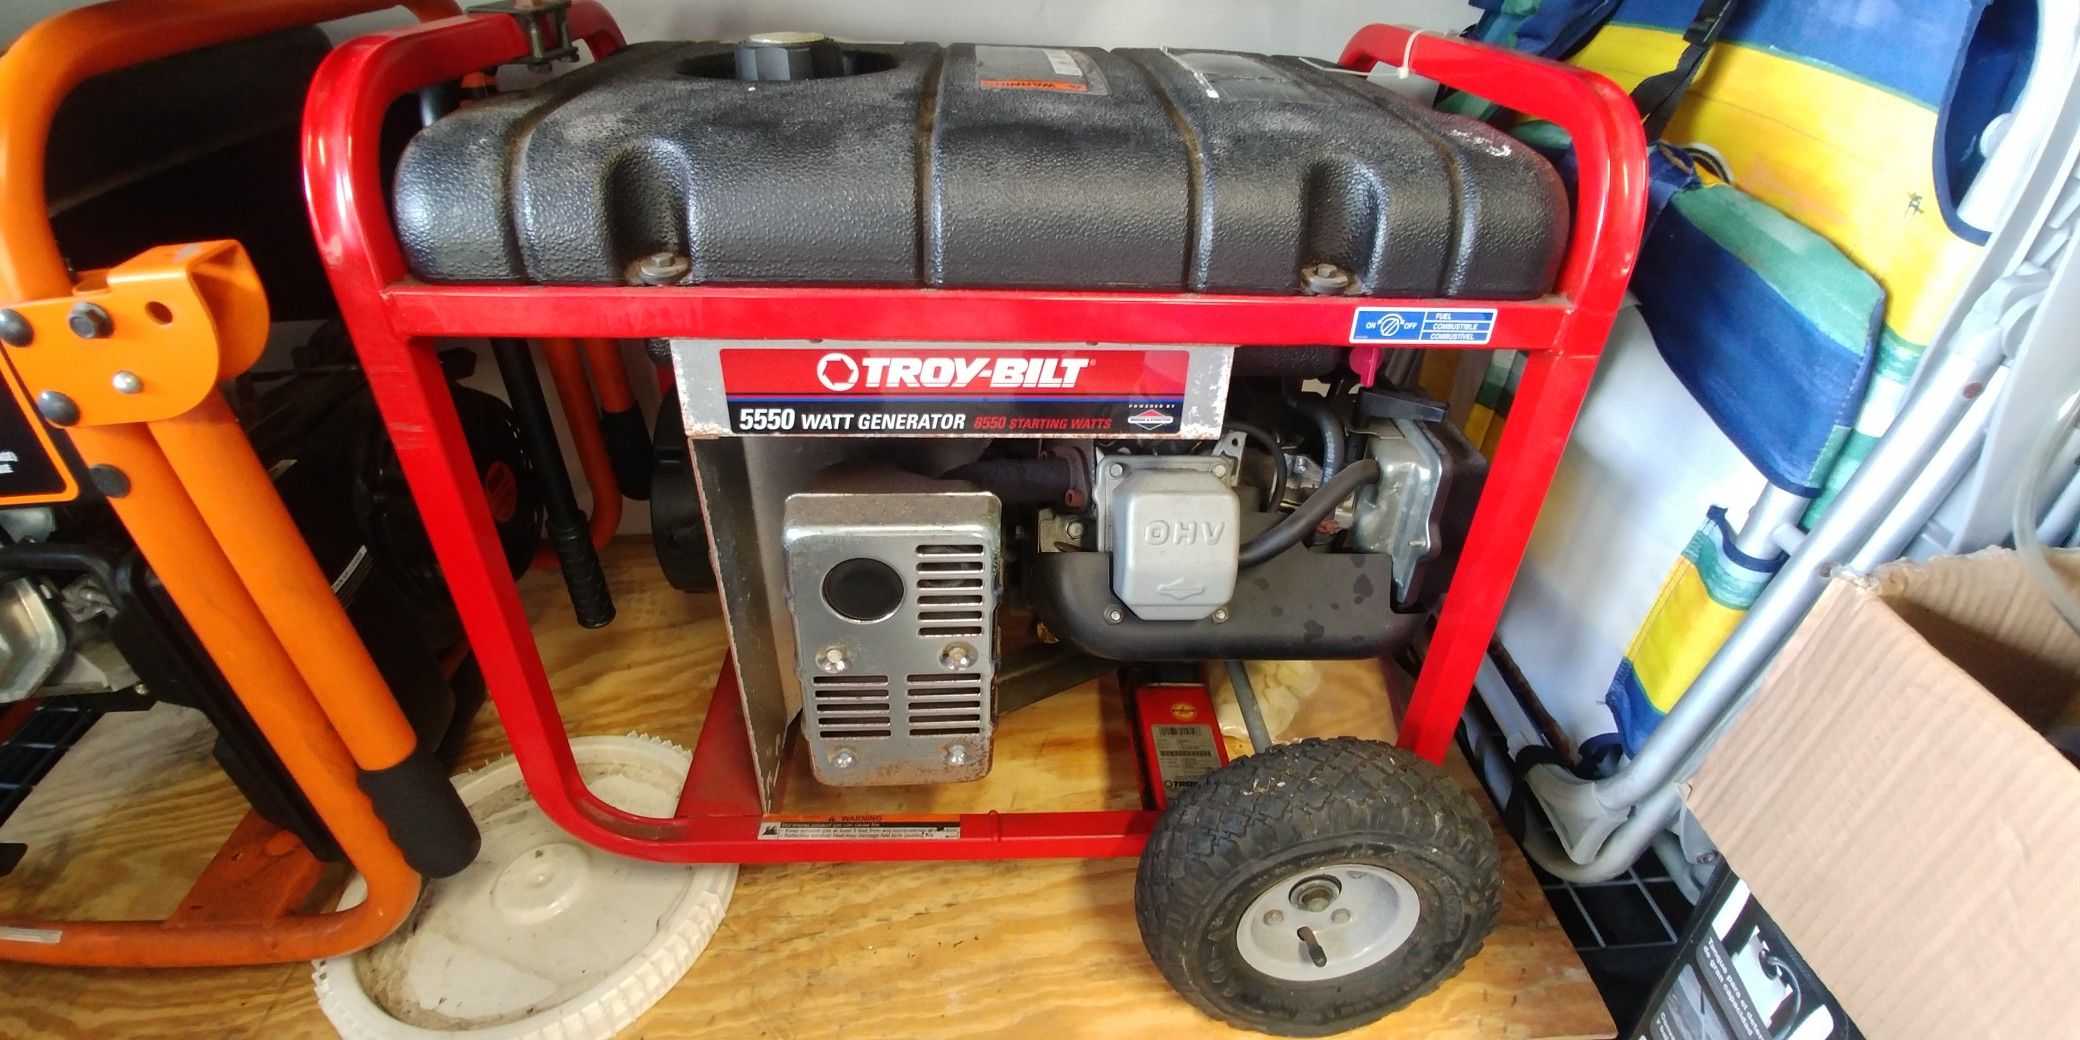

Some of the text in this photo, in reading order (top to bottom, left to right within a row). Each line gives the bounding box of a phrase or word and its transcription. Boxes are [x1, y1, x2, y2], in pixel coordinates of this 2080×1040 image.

[1432, 323, 1478, 331] COMBUSTIBLE
[862, 357, 1090, 388] TROY-BILT
[739, 408, 796, 430] 5550
[801, 413, 855, 430] WATT
[858, 413, 966, 430] GENERATOR
[1009, 417, 1067, 430] STARTING
[1070, 417, 1112, 430] WATTS
[1144, 519, 1225, 546] OHV
[1704, 946, 1753, 1036] de gran capacidad
[1708, 937, 1728, 974] Tanque
[1726, 975, 1740, 998] para
[1746, 1012, 1764, 1040] deter
